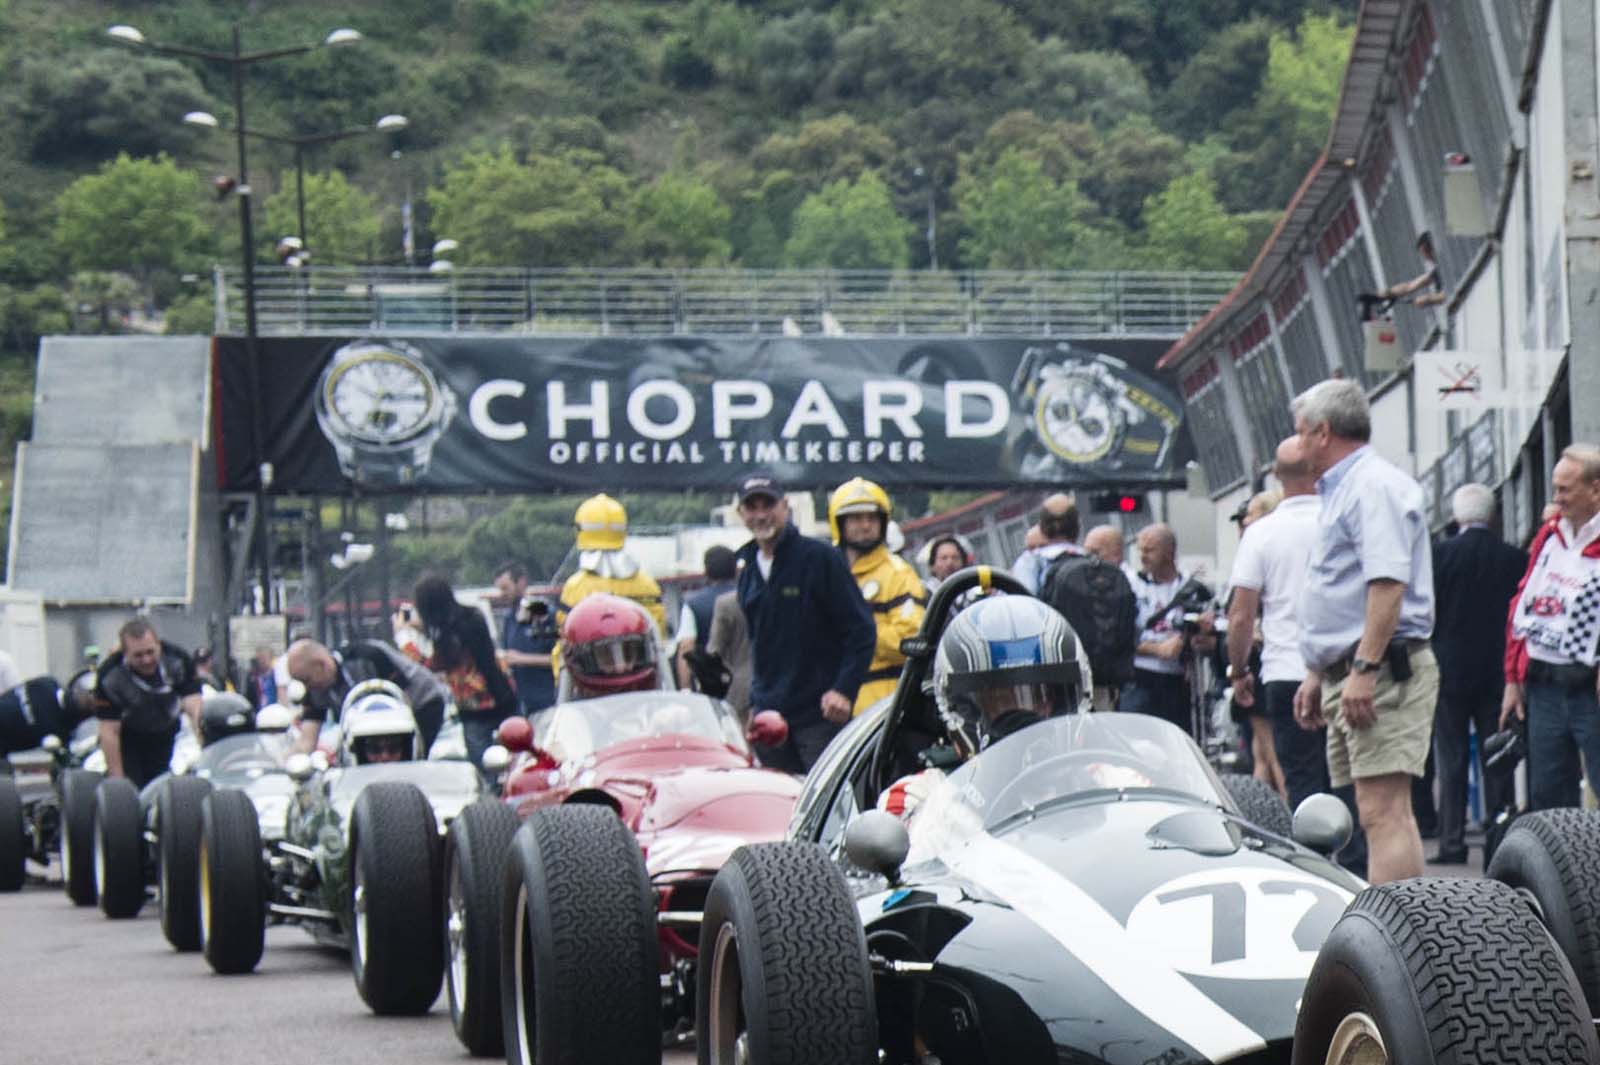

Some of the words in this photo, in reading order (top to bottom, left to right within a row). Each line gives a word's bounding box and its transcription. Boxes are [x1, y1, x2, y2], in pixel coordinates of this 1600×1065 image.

[469, 379, 1011, 440] CHOPARD
[549, 441, 704, 464] OFFICIAL
[719, 441, 926, 463] TIMEKEEPER
